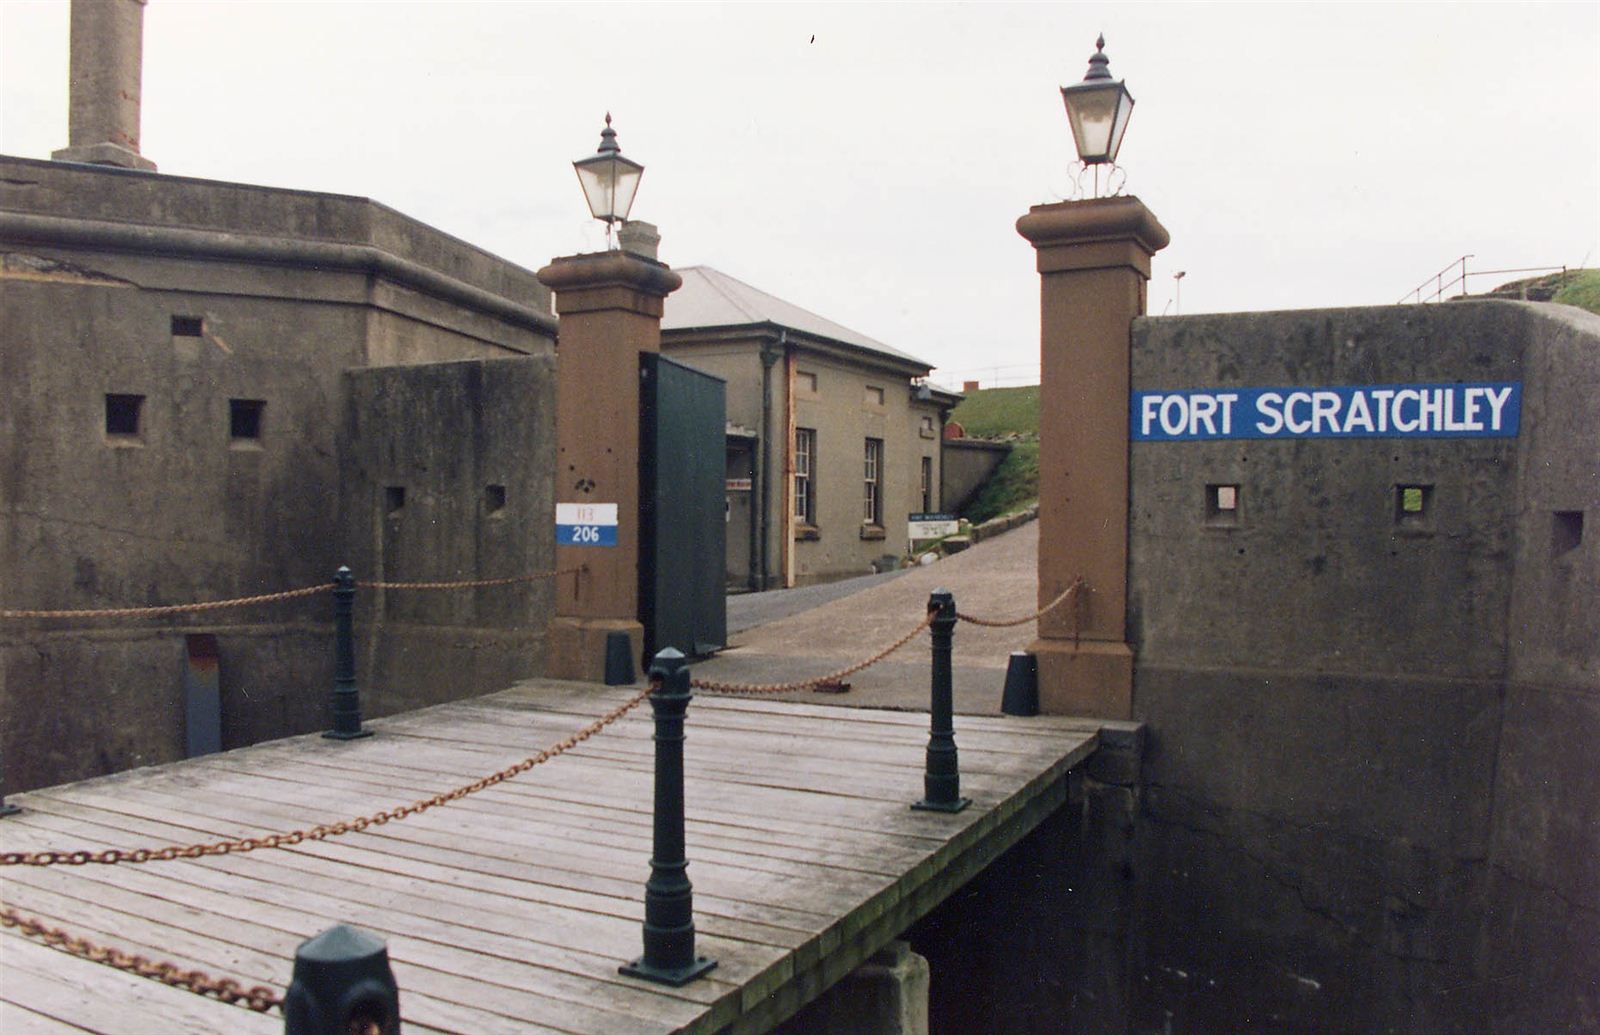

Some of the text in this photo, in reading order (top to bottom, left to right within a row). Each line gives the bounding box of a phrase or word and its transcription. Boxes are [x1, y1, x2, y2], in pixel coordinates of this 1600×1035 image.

[1142, 388, 1512, 435] FORT SCRATCHLEY
[572, 526, 600, 542] 206
